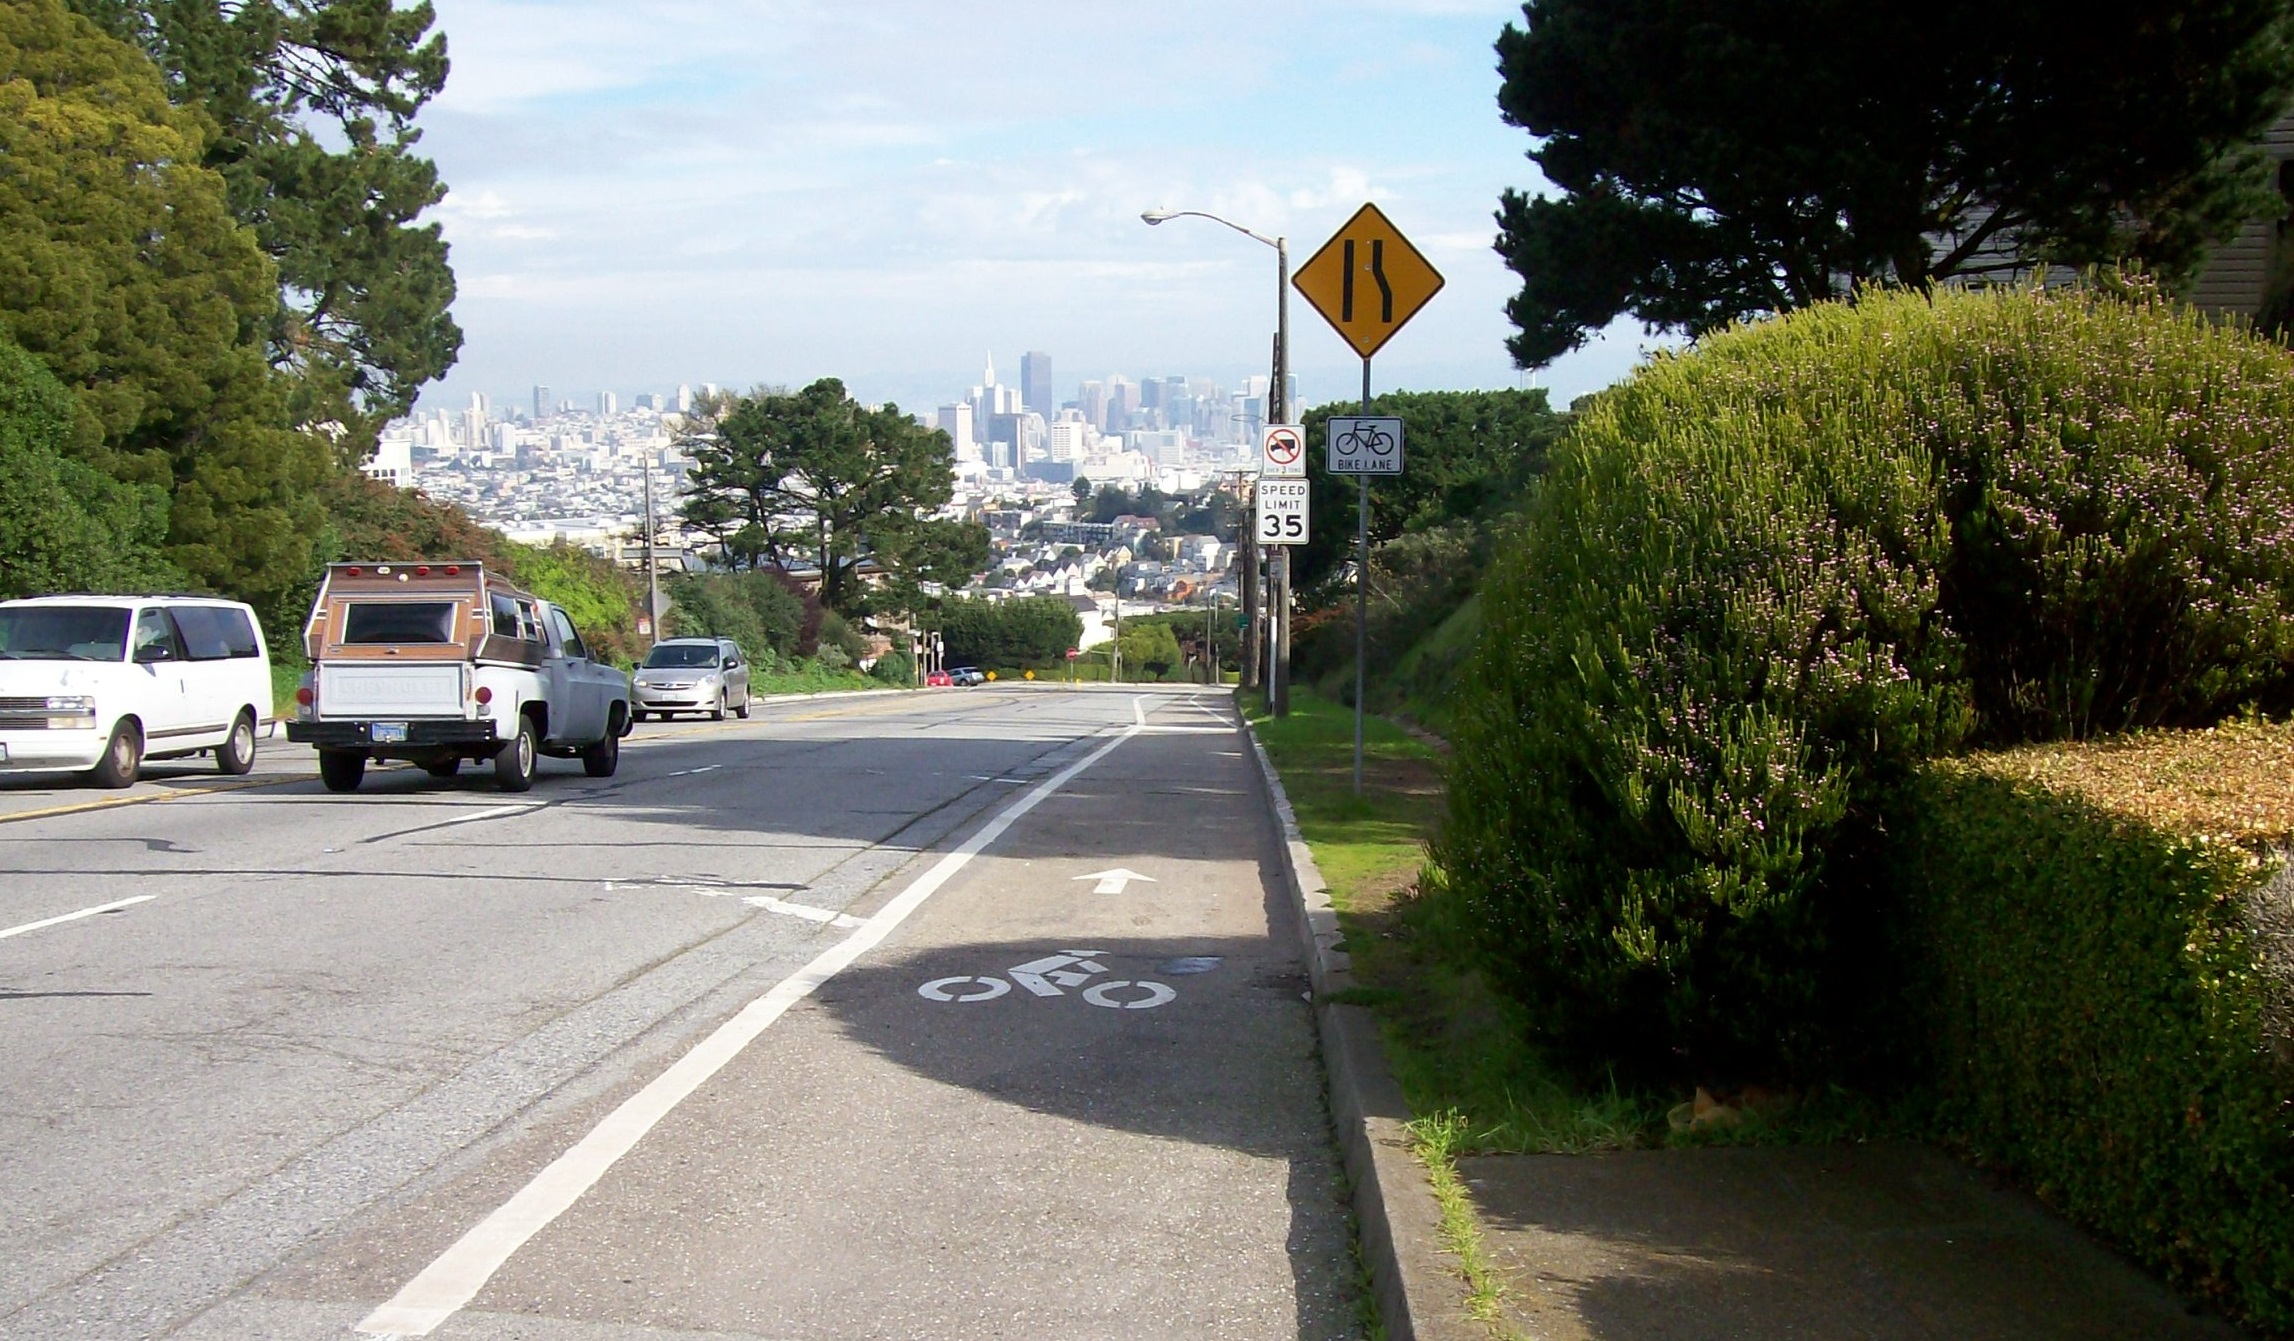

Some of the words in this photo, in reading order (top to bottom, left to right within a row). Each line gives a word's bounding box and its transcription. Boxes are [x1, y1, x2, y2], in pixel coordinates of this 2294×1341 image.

[1338, 459, 1360, 470] BIKE
[1364, 459, 1393, 470] LANE
[1261, 485, 1305, 496] SPEED
[1265, 500, 1300, 510] LIMIT
[1264, 514, 1303, 537] 35
